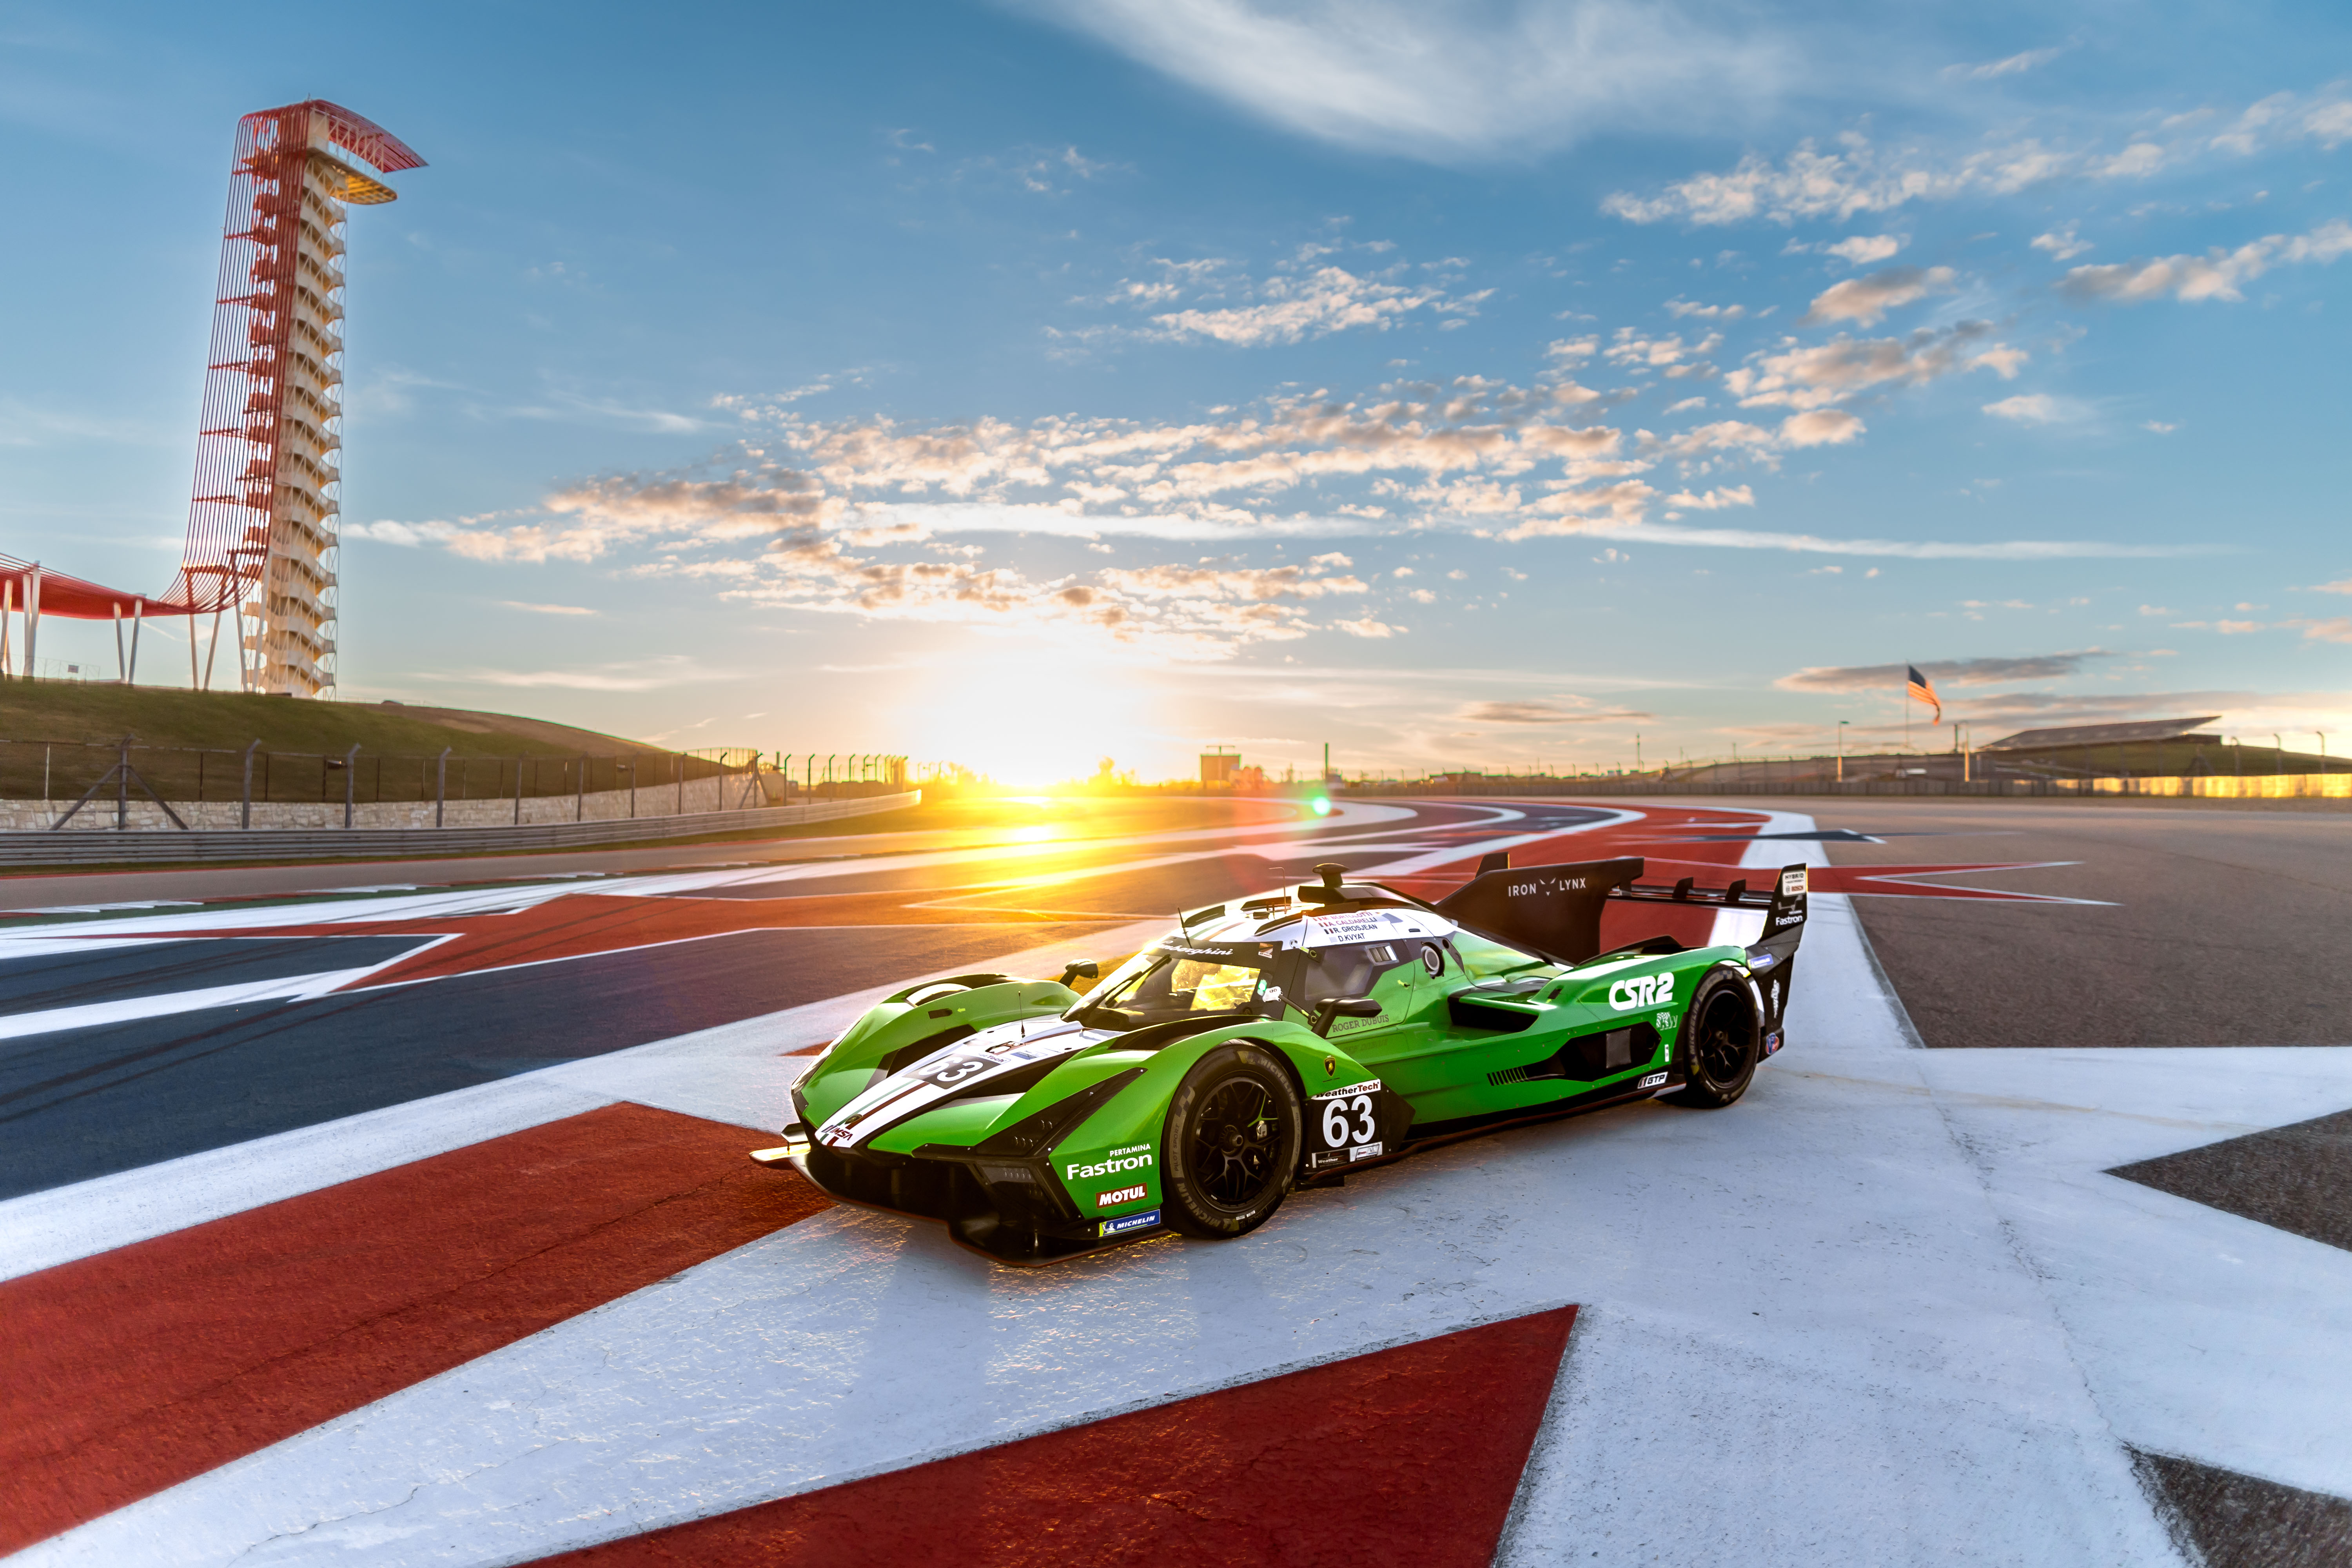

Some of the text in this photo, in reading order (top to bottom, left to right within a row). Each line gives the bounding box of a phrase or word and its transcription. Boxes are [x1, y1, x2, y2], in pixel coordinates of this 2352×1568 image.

[1508, 878, 1586, 897] IRON LYNX
[1336, 917, 1378, 926] CALDARELLI
[1341, 924, 1378, 933] GROSJEAN
[1775, 915, 1803, 926] Fastron
[1608, 972, 1675, 1011] CSR2
[1332, 1014, 1390, 1033] ROGER DUBUIS
[918, 1056, 984, 1082] 63
[1260, 1058, 1296, 1102] MICHELIN
[1647, 1074, 1666, 1085] GTP
[1323, 1094, 1375, 1148] 63
[1109, 1143, 1151, 1157] PERTAMINA
[1067, 1154, 1152, 1180] Fastron
[1099, 1186, 1145, 1206] MOTUL
[1177, 1182, 1221, 1228] MICHELIN
[1116, 1215, 1156, 1229] MICHELIN
